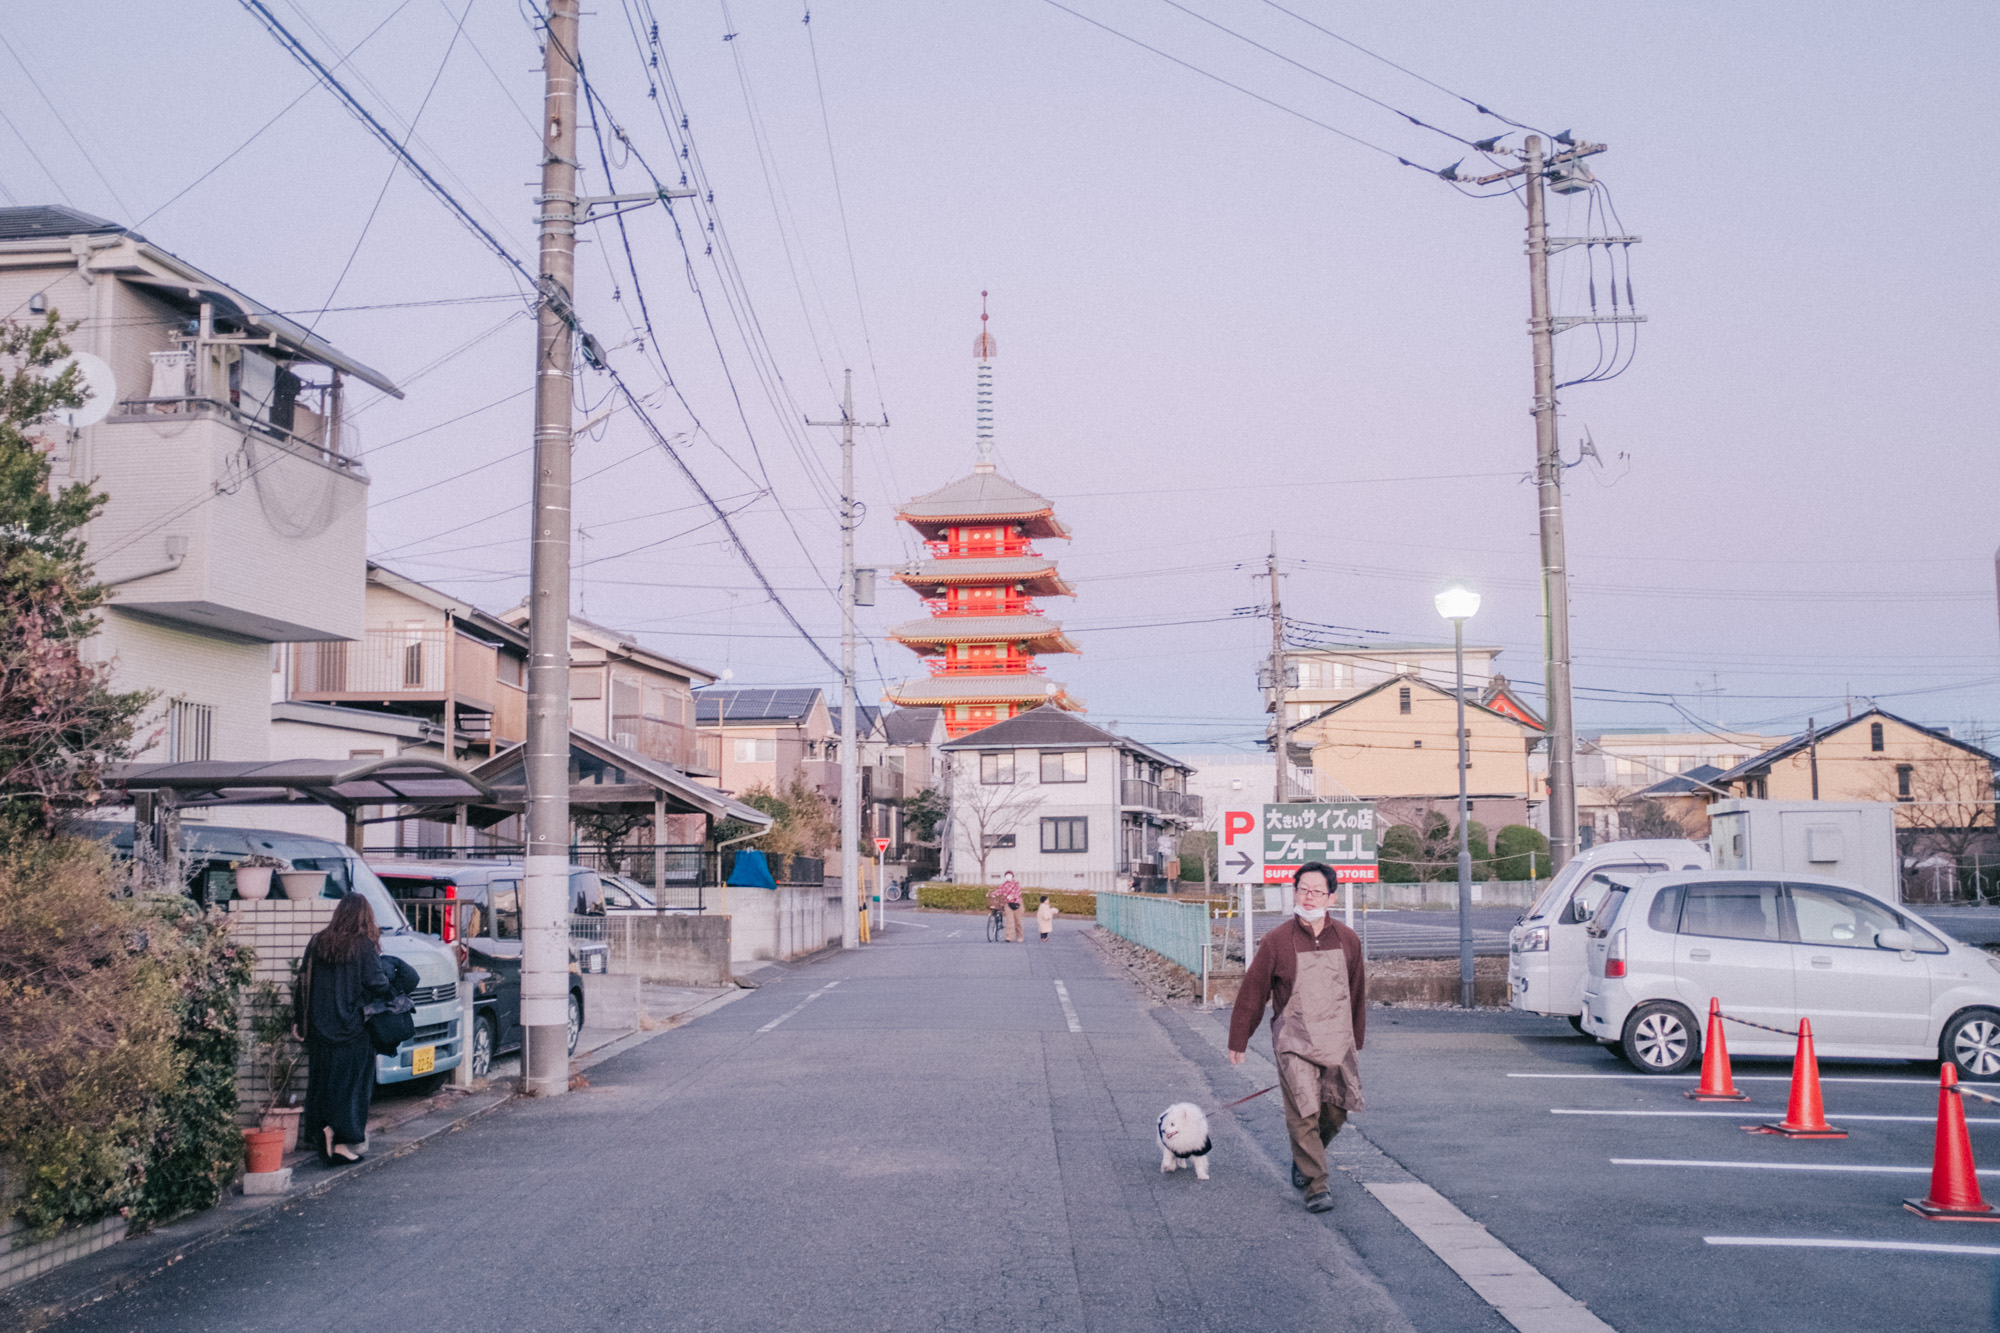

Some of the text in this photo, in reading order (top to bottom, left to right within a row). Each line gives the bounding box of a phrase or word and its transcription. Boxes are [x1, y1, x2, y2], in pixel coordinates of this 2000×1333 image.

[1225, 811, 1255, 845] P
[1266, 808, 1373, 830] 大きいサイズの店
[1265, 834, 1374, 860] フォーエル
[1265, 869, 1374, 879] SUPE STORE
